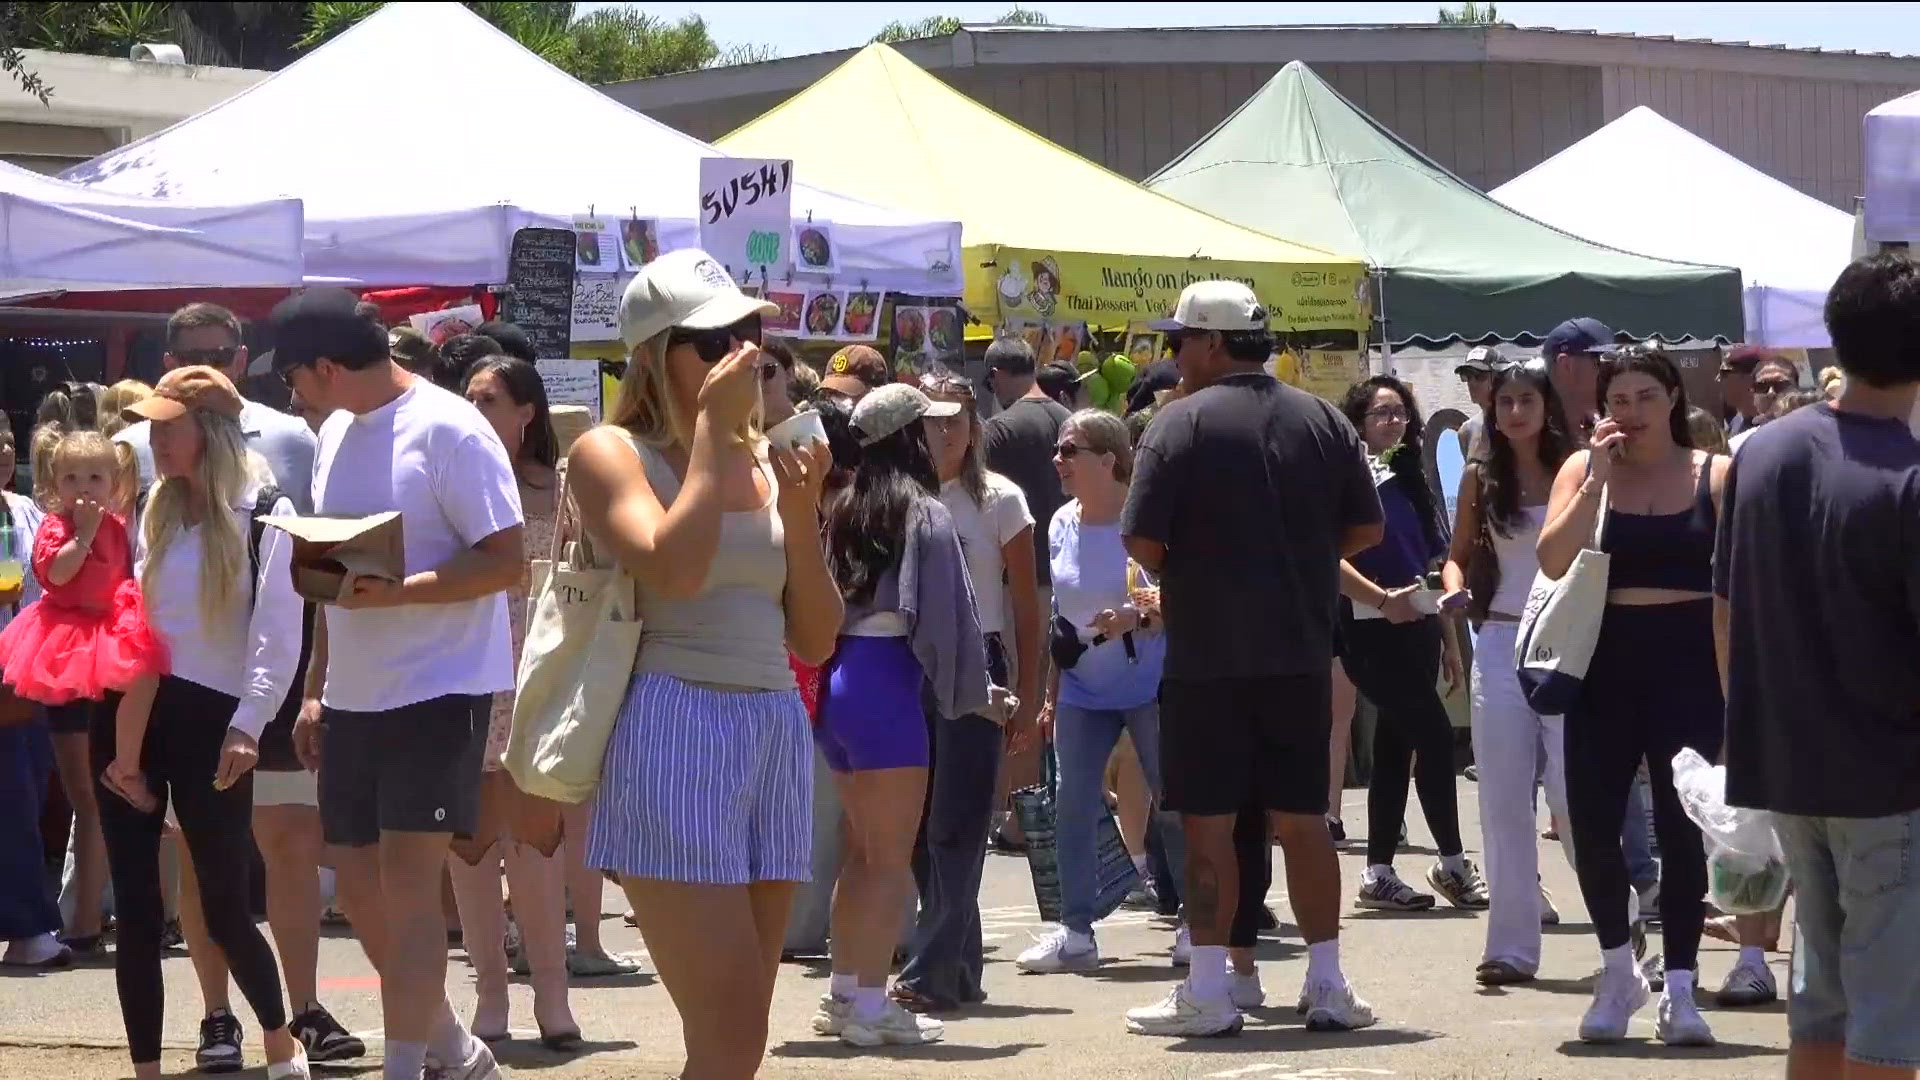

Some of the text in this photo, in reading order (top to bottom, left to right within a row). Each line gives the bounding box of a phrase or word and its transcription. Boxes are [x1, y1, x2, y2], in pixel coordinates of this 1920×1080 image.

[701, 160, 790, 225] SUSHI
[1101, 267, 1153, 298] Mango
[1156, 273, 1177, 290] on
[1066, 294, 1093, 311] Thai
[1096, 296, 1139, 313] Dessert
